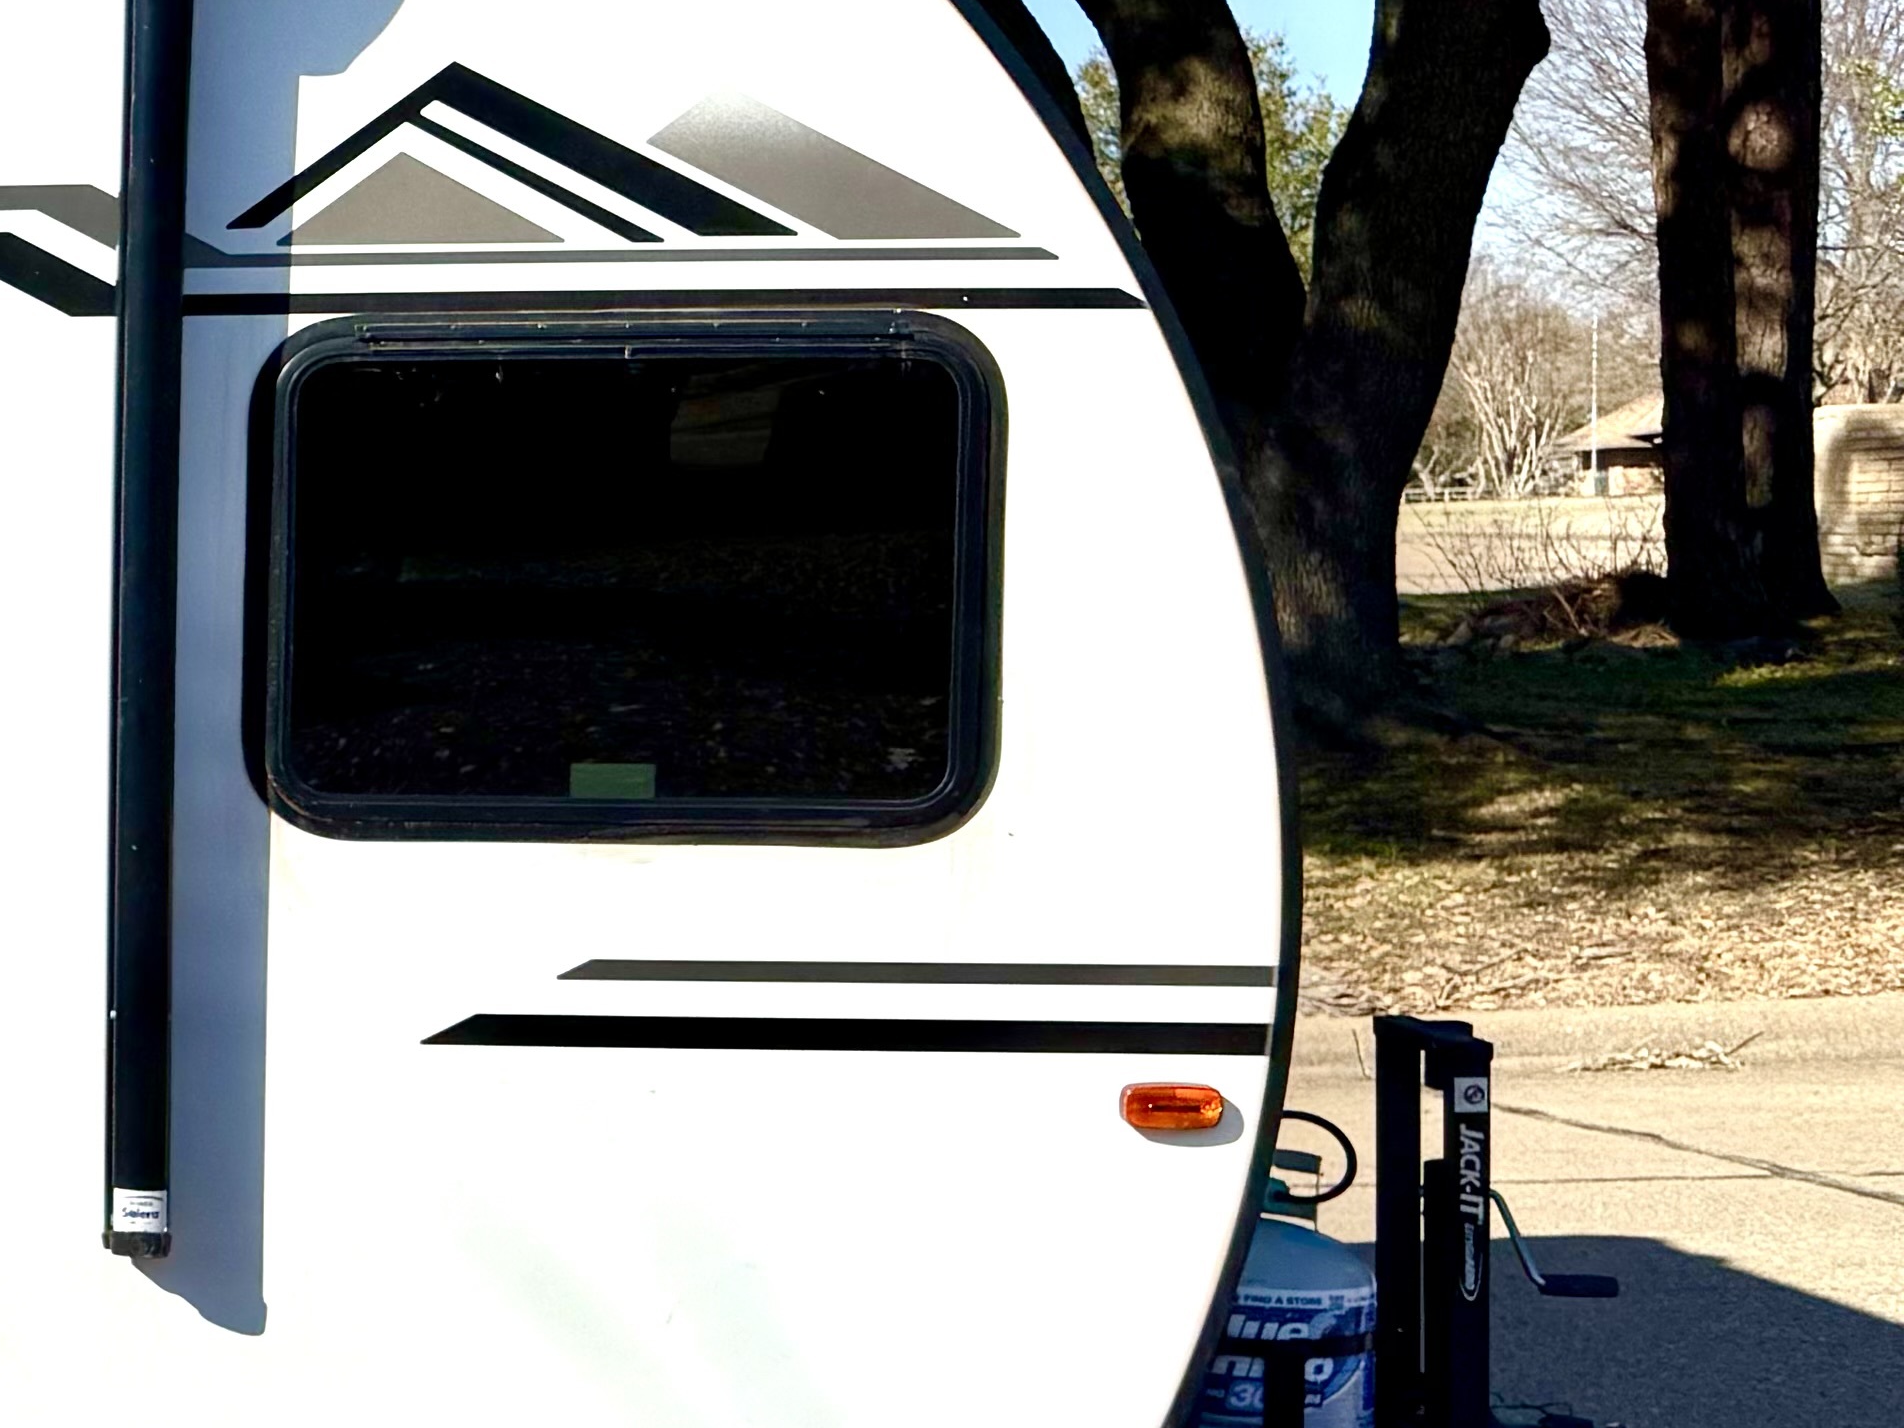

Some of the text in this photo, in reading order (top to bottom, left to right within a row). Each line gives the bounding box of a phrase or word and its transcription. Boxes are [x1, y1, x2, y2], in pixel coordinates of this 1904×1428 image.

[1459, 1123, 1486, 1225] JACK-IT
[1273, 1295, 1284, 1305] A
[1286, 1295, 1322, 1306] STORE
